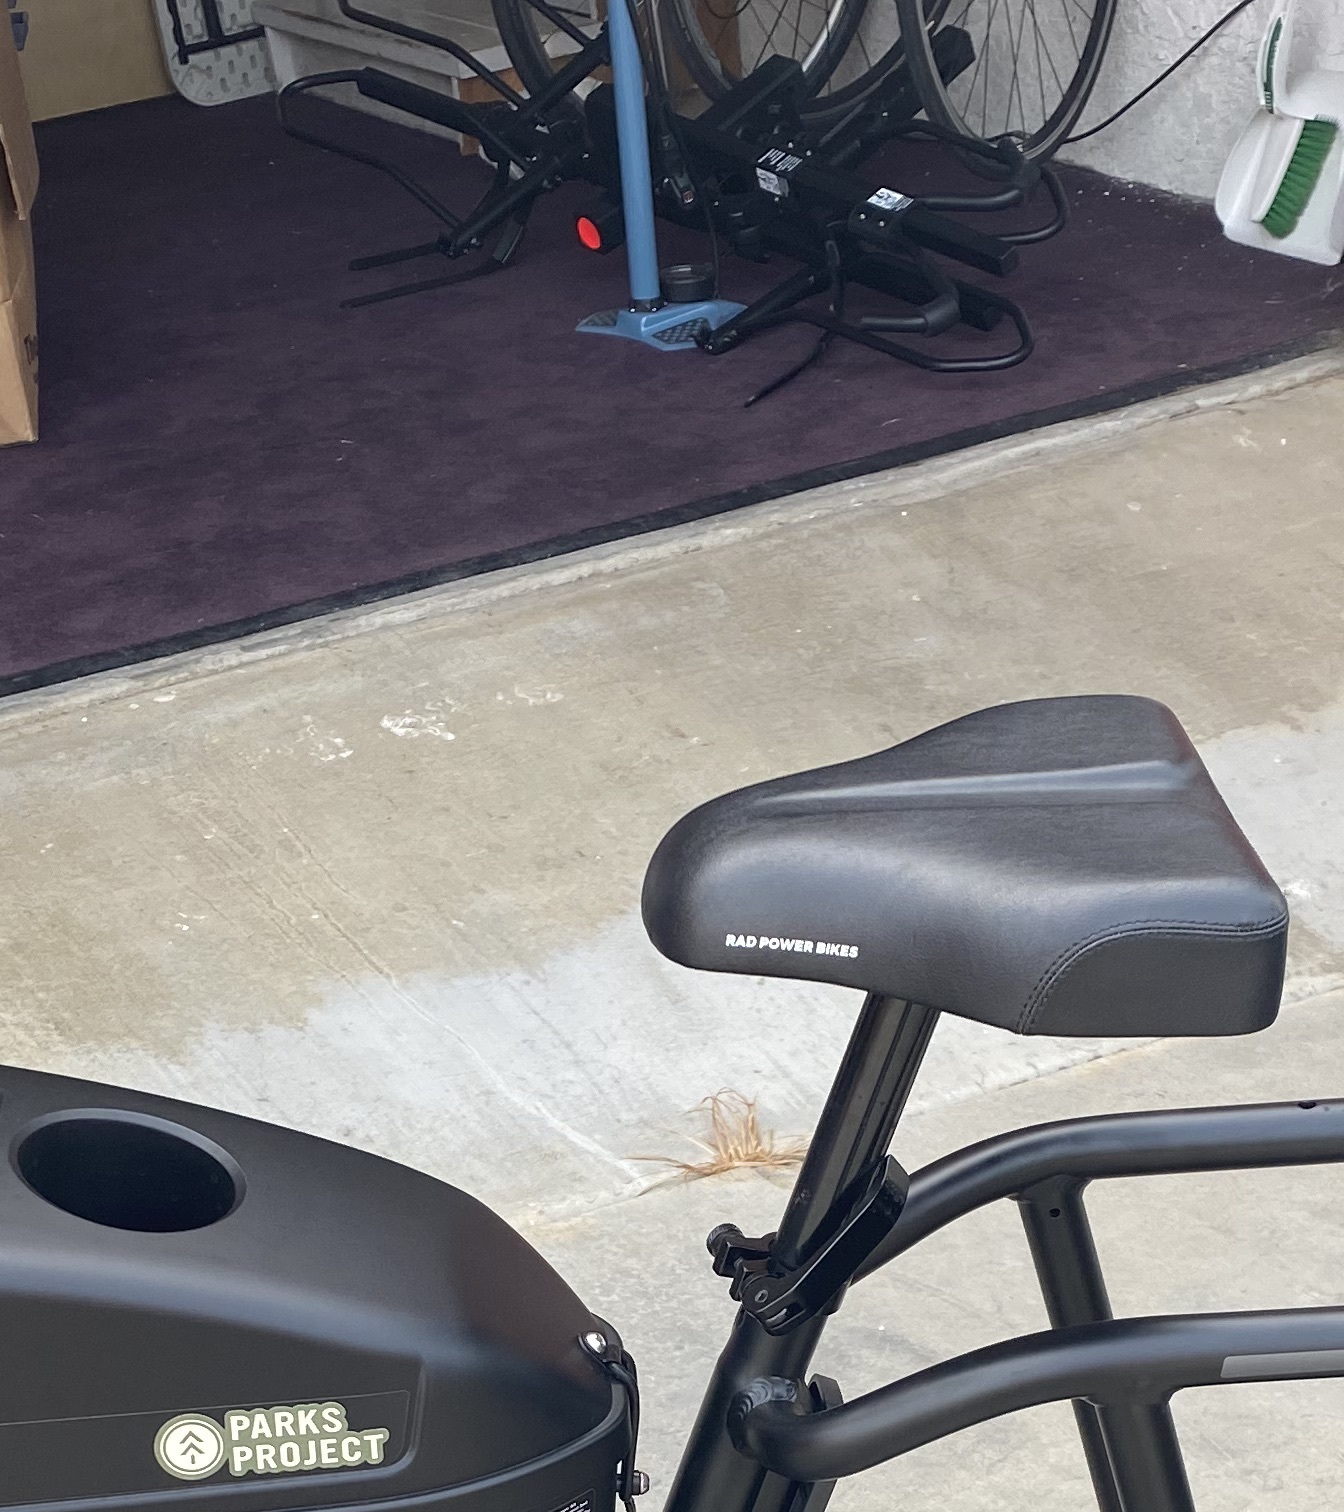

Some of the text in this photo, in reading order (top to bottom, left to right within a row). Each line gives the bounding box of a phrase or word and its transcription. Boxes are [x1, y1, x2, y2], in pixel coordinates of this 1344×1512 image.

[725, 933, 859, 959] RAD POWER BIKES
[229, 1407, 343, 1441] PARKS
[232, 1434, 384, 1472] PROJECT
